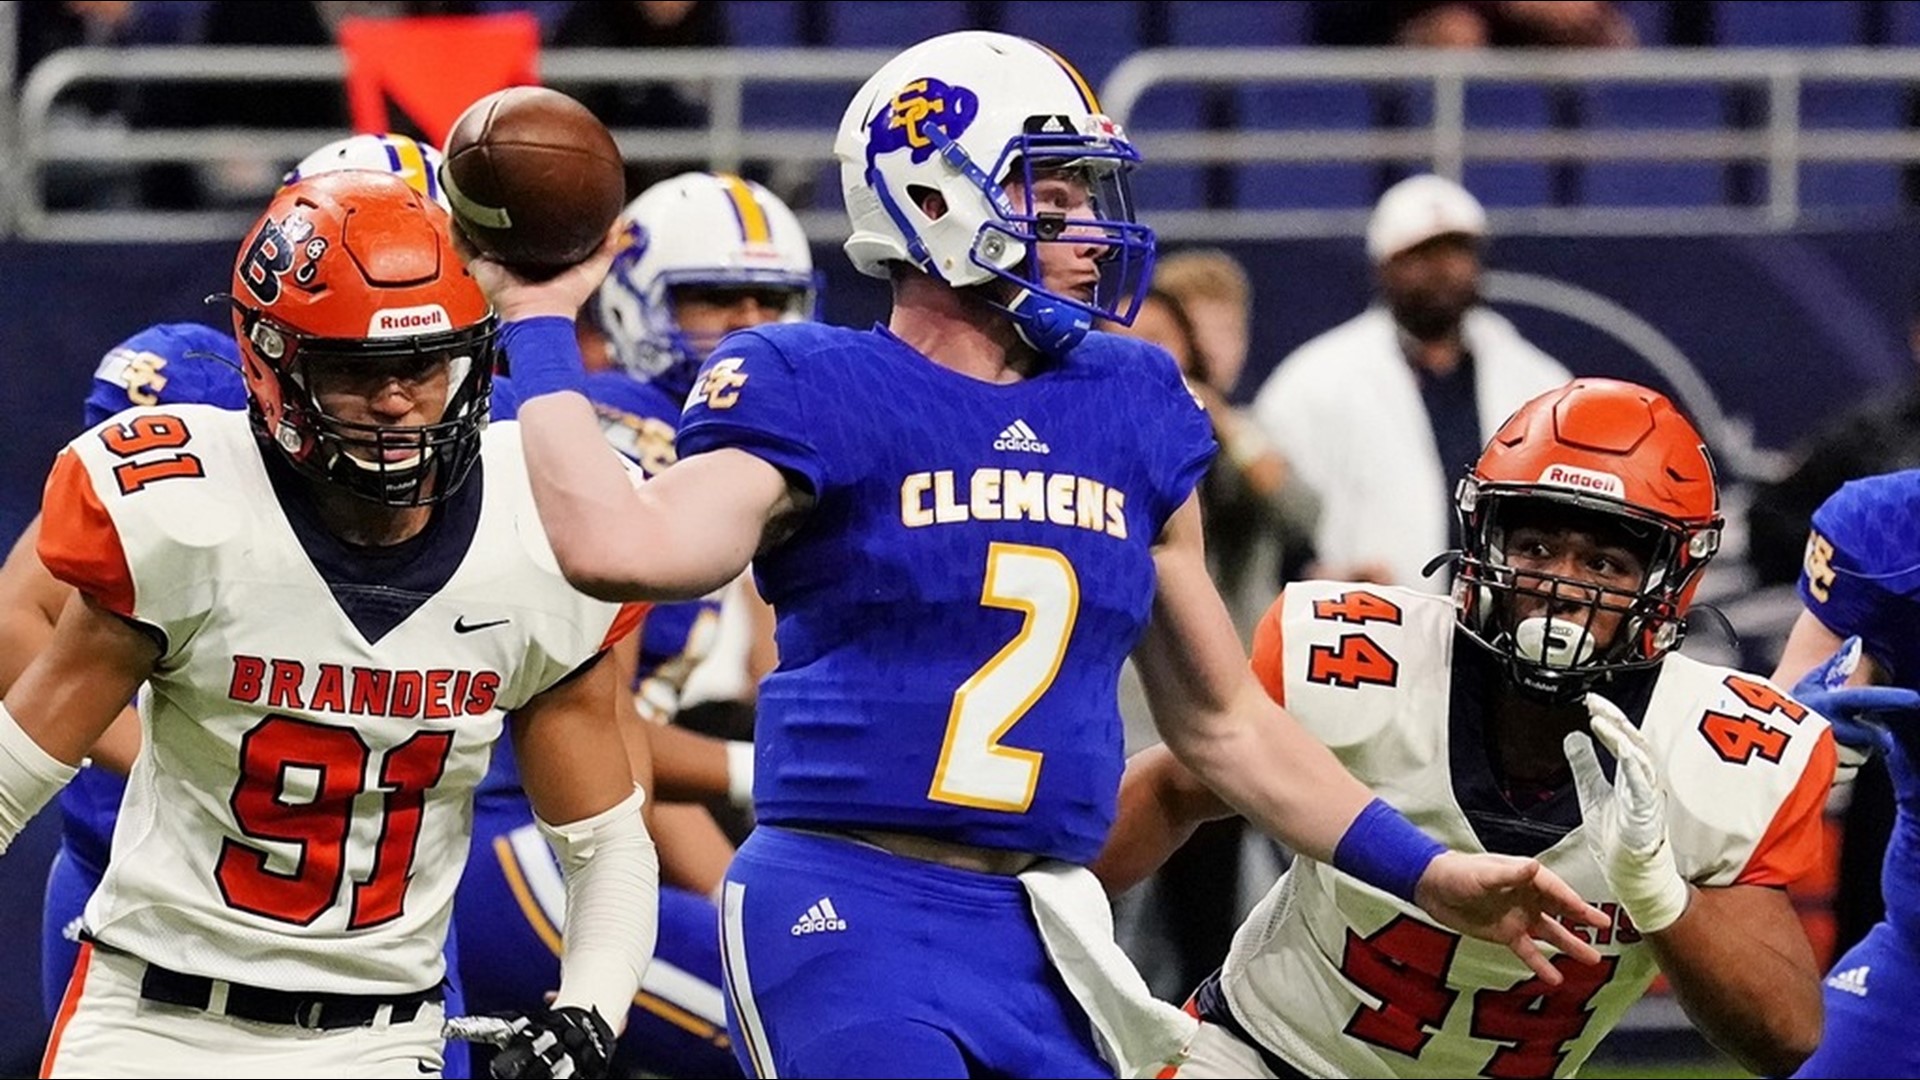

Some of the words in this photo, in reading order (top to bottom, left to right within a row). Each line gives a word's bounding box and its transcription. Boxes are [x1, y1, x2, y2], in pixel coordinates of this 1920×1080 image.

[380, 310, 442, 330] Riddell
[97, 413, 206, 497] 91
[993, 436, 1051, 455] adidas
[1550, 466, 1616, 492] Riddell
[900, 467, 1129, 541] CLEMENS
[927, 541, 1081, 814] 2
[1306, 590, 1403, 690] 44
[228, 655, 501, 720] BRANDEIS
[1697, 674, 1810, 767] 44
[213, 712, 454, 931] 91
[791, 917, 847, 936] adidas
[1340, 911, 1621, 1079] 44
